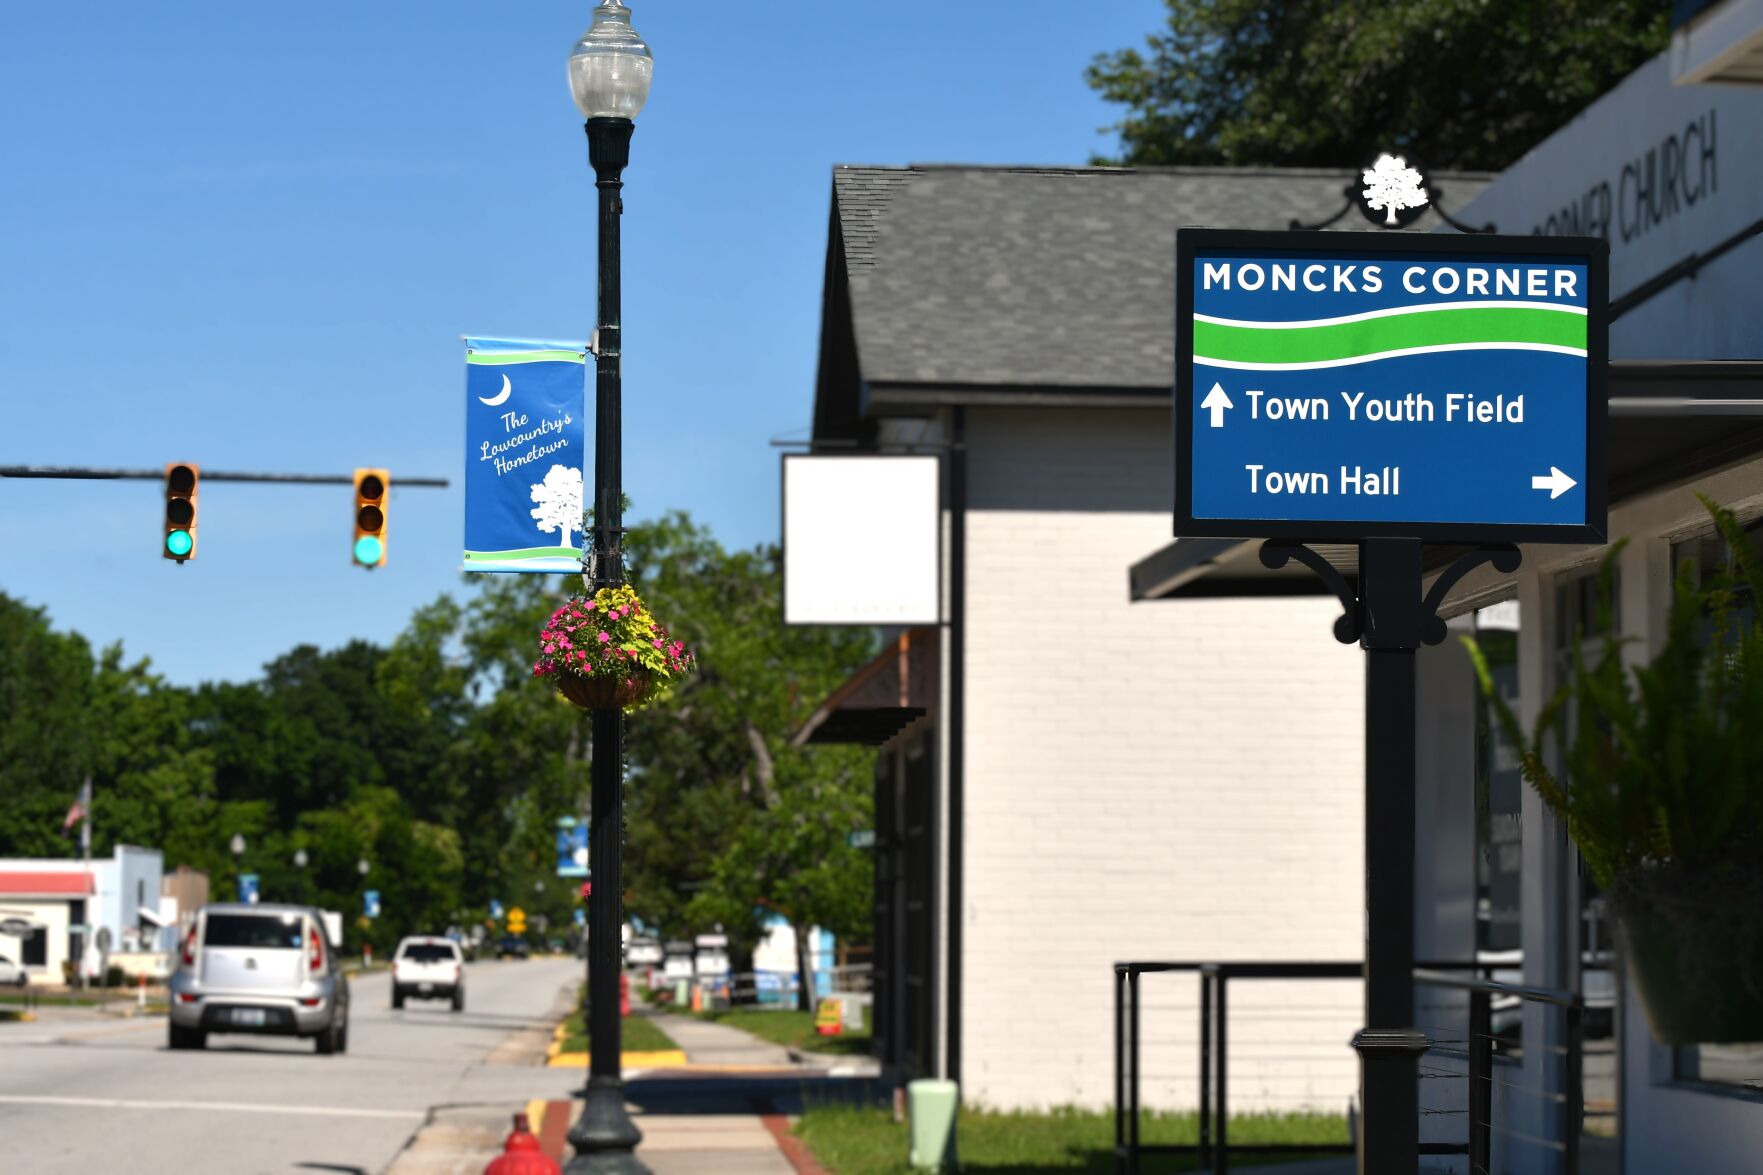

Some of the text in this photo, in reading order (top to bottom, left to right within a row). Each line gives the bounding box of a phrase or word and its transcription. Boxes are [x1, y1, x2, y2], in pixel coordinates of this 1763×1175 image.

[1532, 109, 1717, 243] NER CHURCH
[1202, 263, 1579, 298] MONCKS CORNER
[500, 411, 528, 432] The
[1245, 390, 1525, 424] Town Youth Field
[480, 409, 573, 460] Lowcountry's
[494, 439, 568, 476] Hometown
[1245, 464, 1401, 496] Town Hall
